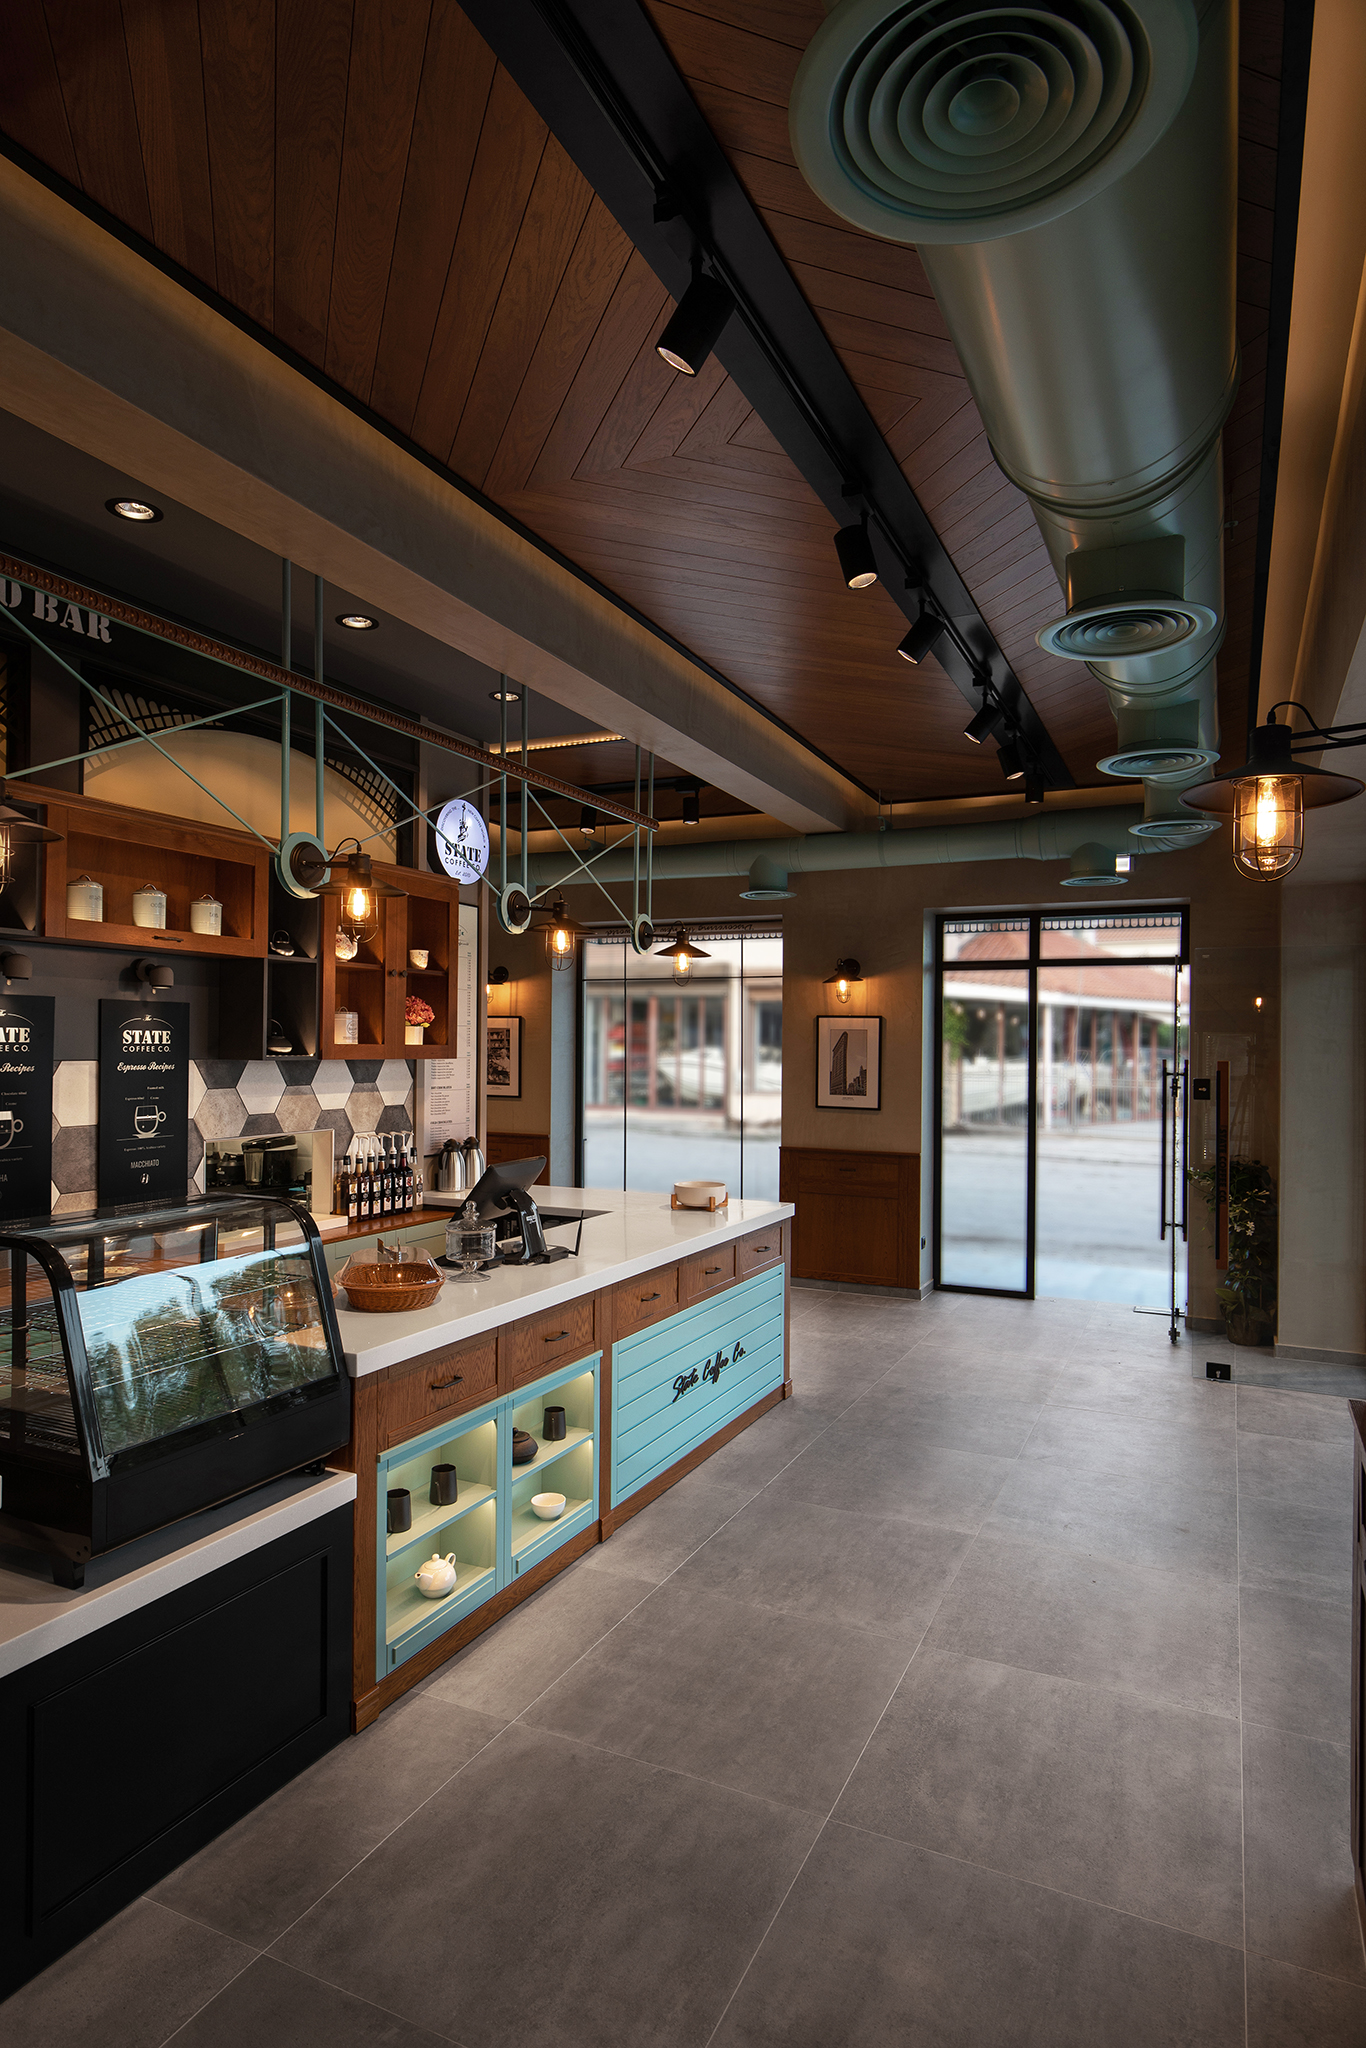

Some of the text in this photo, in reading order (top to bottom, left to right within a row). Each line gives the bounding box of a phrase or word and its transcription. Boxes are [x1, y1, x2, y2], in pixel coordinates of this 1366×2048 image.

[32, 591, 112, 644] BAR
[444, 841, 482, 864] STATE
[444, 857, 471, 869] COFFEE
[698, 923, 755, 931] Discovering
[122, 1029, 171, 1045] STATE
[13, 1044, 30, 1052] CO.
[122, 1045, 171, 1053] COFFEE CO.
[0, 1062, 35, 1075] Recipes
[116, 1061, 175, 1073] Espresso Recipes
[130, 1158, 160, 1169] MACCHIATO
[1219, 1155, 1227, 1187] COFFEE
[672, 1341, 747, 1403] State Coffee Co.
